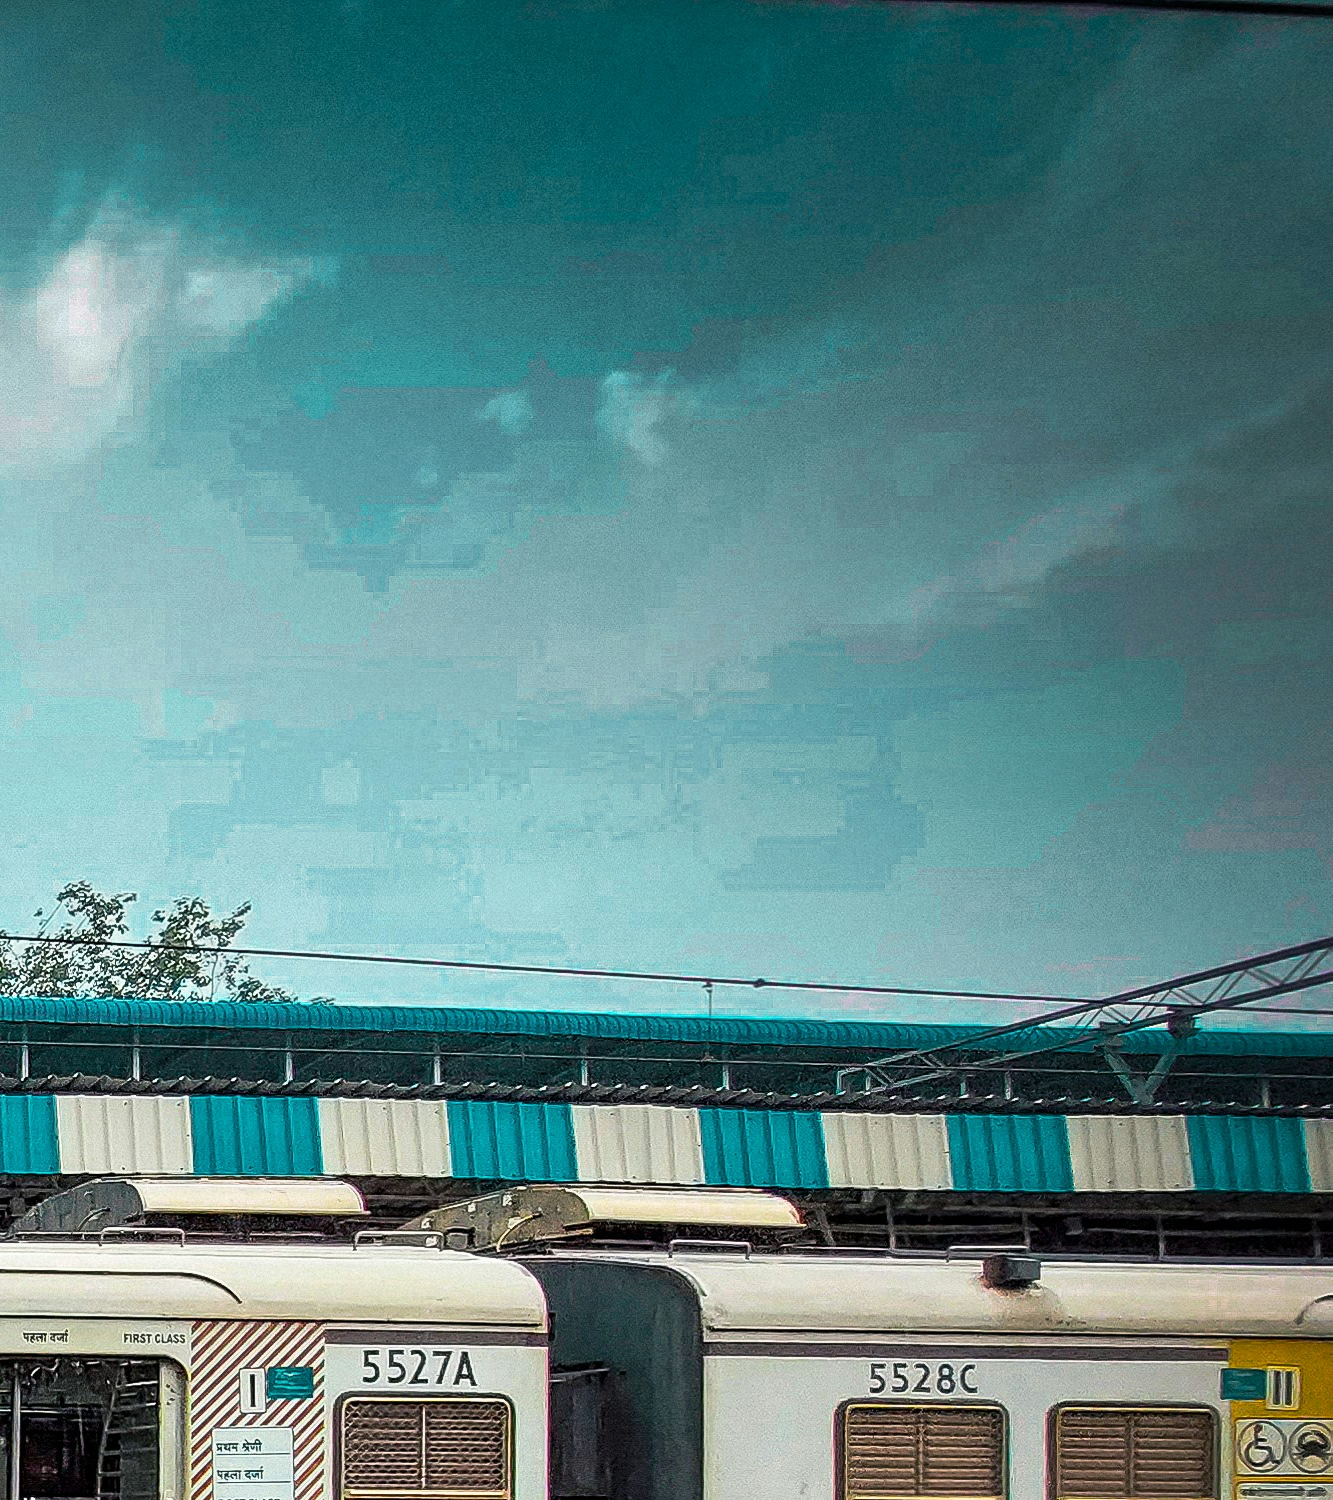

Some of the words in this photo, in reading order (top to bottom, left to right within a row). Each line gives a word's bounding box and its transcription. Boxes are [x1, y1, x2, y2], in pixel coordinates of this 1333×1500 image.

[23, 1331, 46, 1343] पहला
[49, 1328, 69, 1343] दर्जा
[124, 1333, 152, 1344] FIRST
[154, 1333, 186, 1344] CLASS
[362, 1349, 478, 1387] 5527A
[869, 1362, 978, 1394] 5528C
[216, 1443, 238, 1452] प्रथम
[241, 1439, 262, 1452] श्रेणी
[217, 1470, 241, 1481] पहला
[244, 1466, 264, 1480] दर्जा
